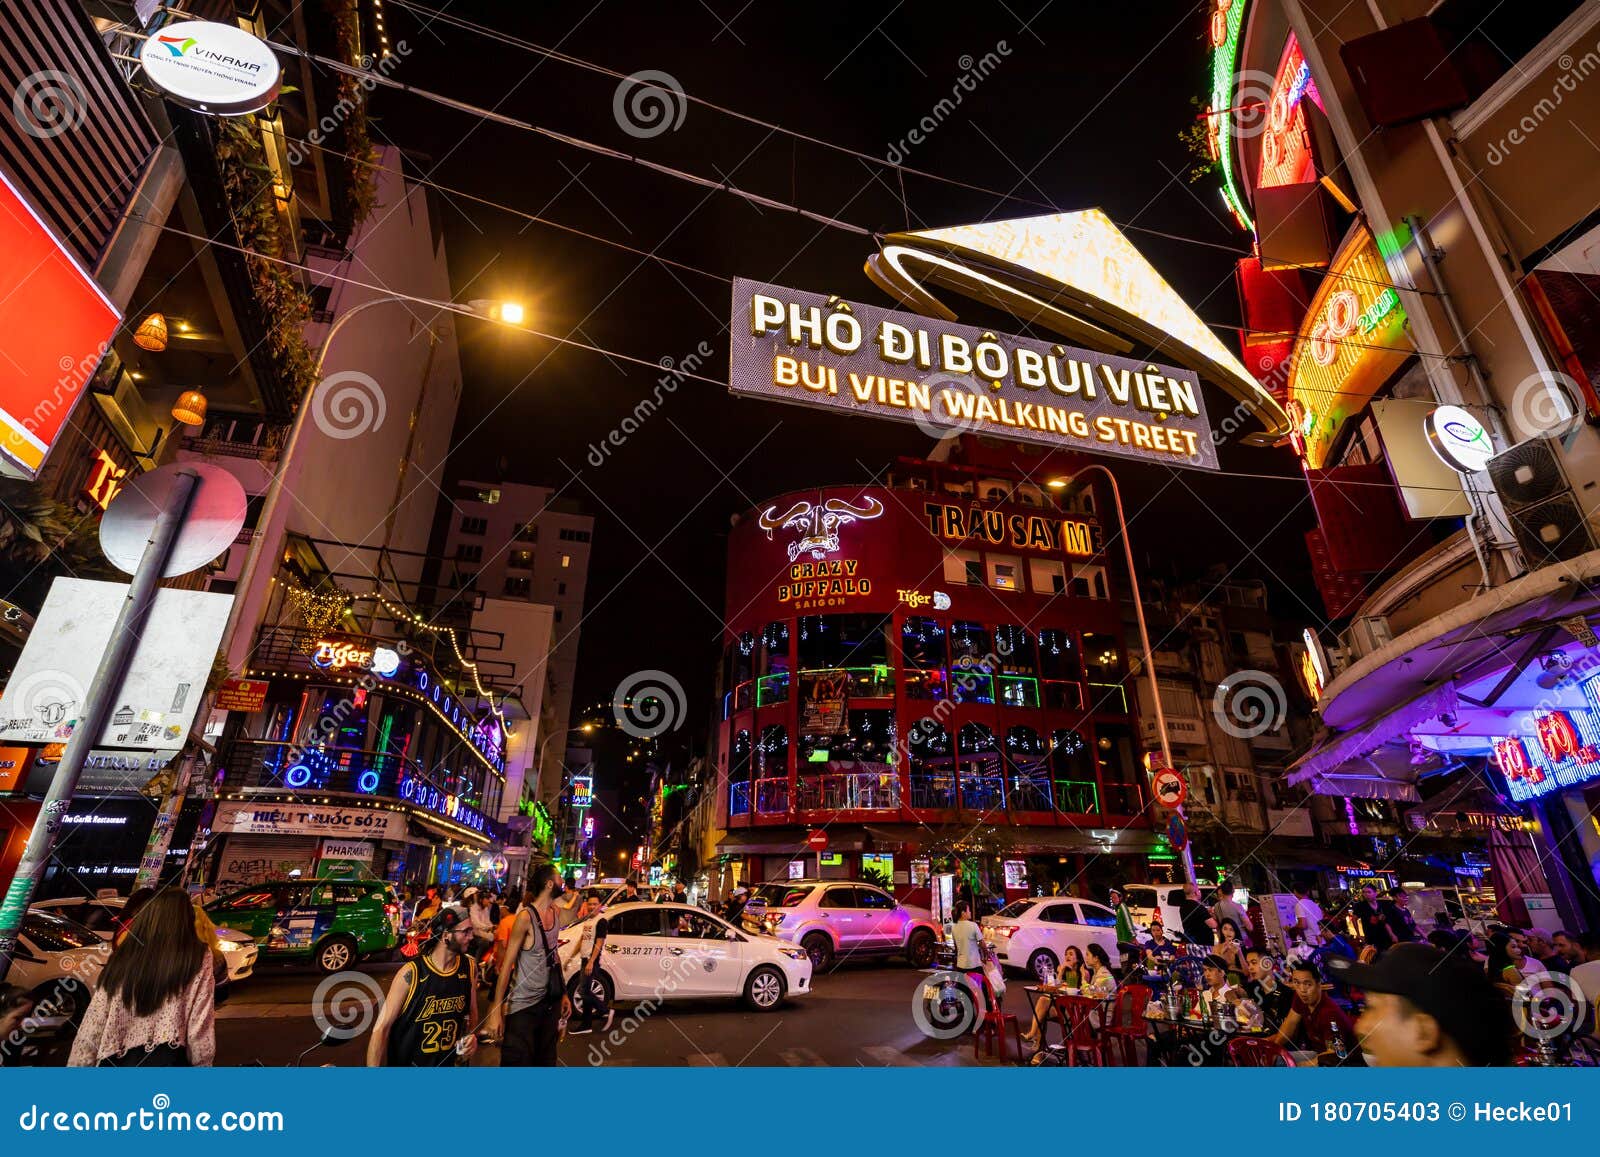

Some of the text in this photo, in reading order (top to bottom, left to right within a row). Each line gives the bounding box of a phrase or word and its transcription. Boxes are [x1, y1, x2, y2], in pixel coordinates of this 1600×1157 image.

[195, 48, 261, 72] VINAMA
[752, 294, 1199, 422] PHỐ ĐI BỘ BÙI VIỆN
[774, 355, 1197, 456] BUI VIEN WALKING STREET
[924, 500, 1005, 544] TRÂU
[1009, 514, 1062, 550] SAY
[790, 560, 857, 580] CRAZY
[778, 579, 872, 602] BUFFALO
[897, 589, 932, 608] Tiger
[795, 598, 846, 609] SAIGON
[317, 641, 371, 668] Tiger
[253, 809, 388, 828] HIỆU THUỐC SỐ 22
[415, 995, 466, 1022] LAKERS
[421, 1019, 458, 1054] 23
